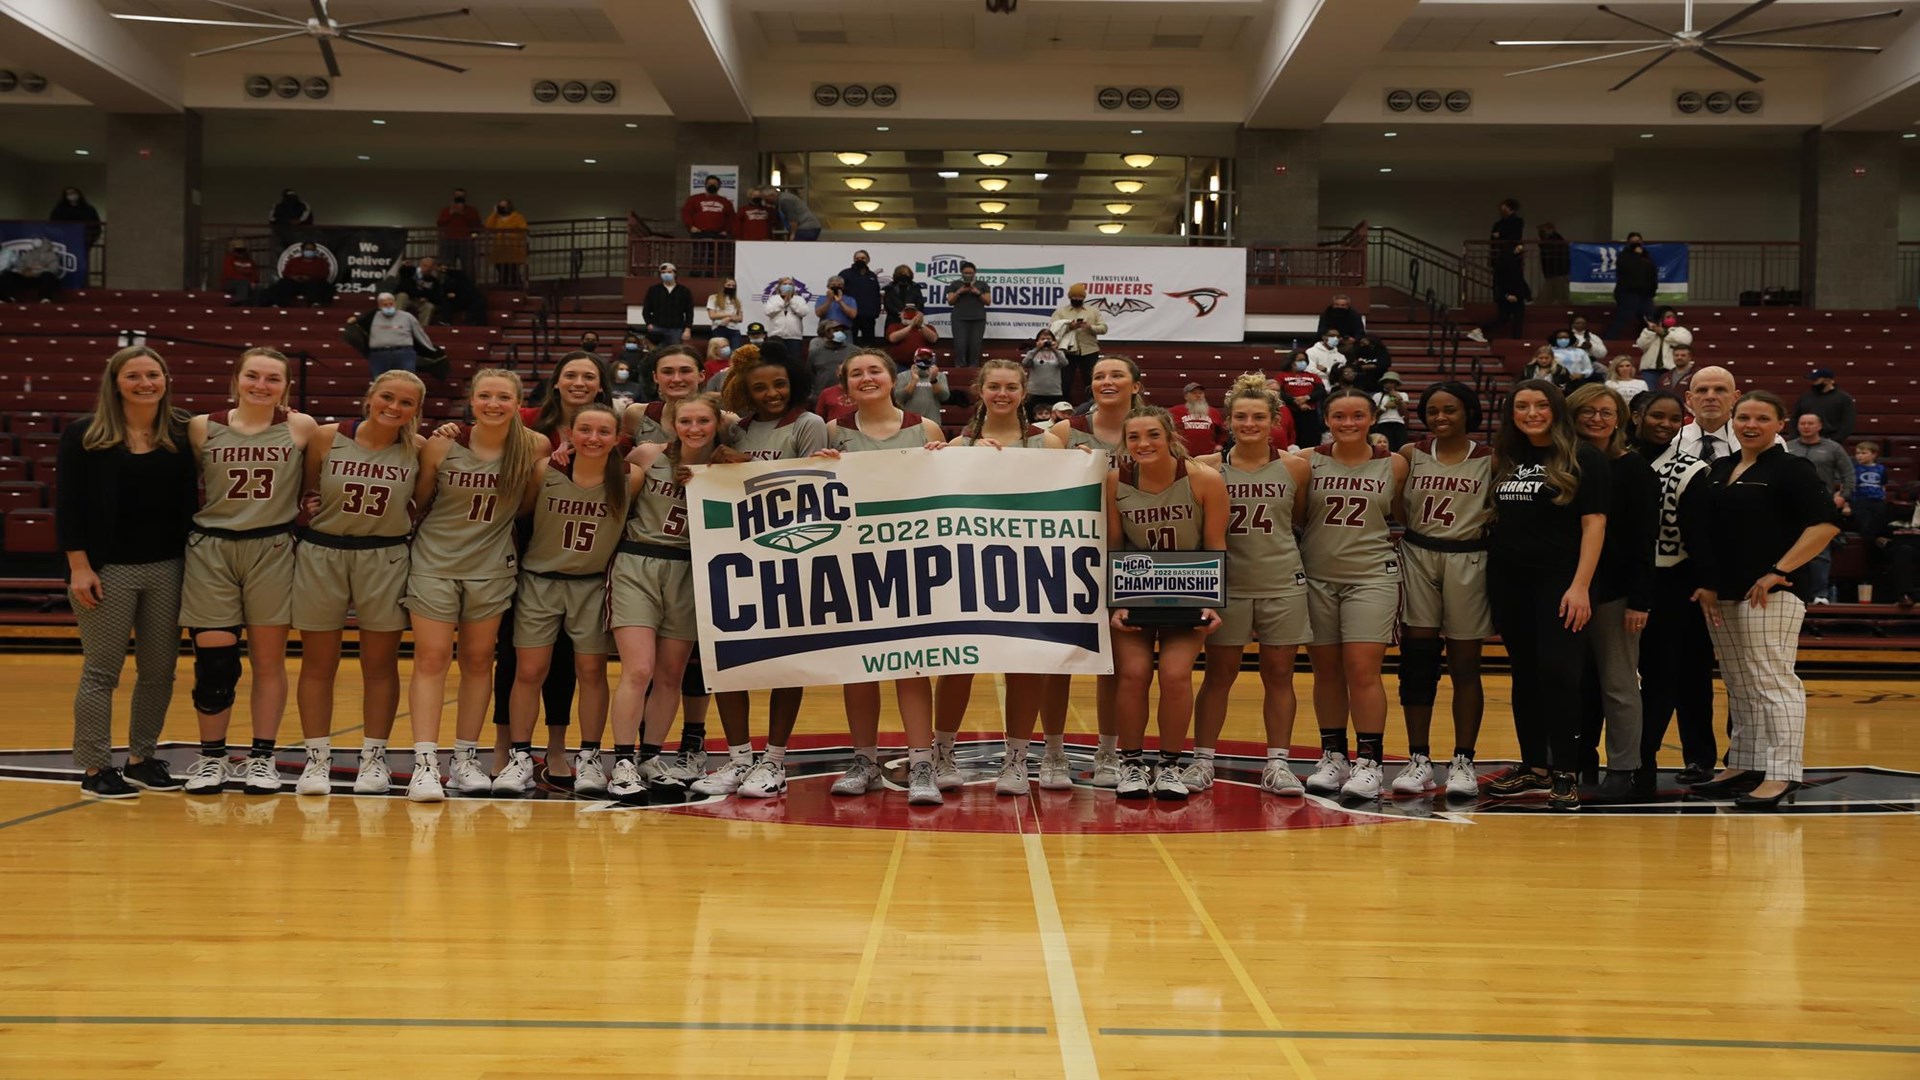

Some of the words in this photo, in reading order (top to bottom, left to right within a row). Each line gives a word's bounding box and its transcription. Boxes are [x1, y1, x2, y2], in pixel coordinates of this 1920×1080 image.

[359, 242, 379, 252] We
[347, 255, 392, 266] Deliver
[927, 259, 963, 278] HCA
[975, 275, 998, 284] 022
[1000, 276, 1064, 285] BASKETBALL
[210, 446, 293, 463] TRANSY
[329, 459, 410, 482] TRANSY
[448, 470, 500, 488] TRAN
[226, 467, 274, 500] 23
[1226, 483, 1287, 499] RANSY
[1313, 476, 1386, 494] TRANSY
[1411, 475, 1482, 495] TRANSY
[342, 482, 391, 518] 33
[467, 494, 497, 523] 11
[547, 496, 608, 518] TRANS
[1421, 494, 1455, 527] 14
[737, 482, 851, 542] HCAC
[1120, 504, 1194, 525] TRANSY
[1229, 503, 1274, 536] 24
[1324, 495, 1368, 528] 22
[562, 519, 597, 553] 15
[857, 518, 929, 545] 2022
[936, 515, 1101, 541] BASKETBALL
[1123, 559, 1152, 572] HCAC
[708, 543, 1101, 633] CHAMPIONS
[1114, 575, 1219, 591] CHAMPIONSHIP
[861, 645, 980, 673] WOMENS
